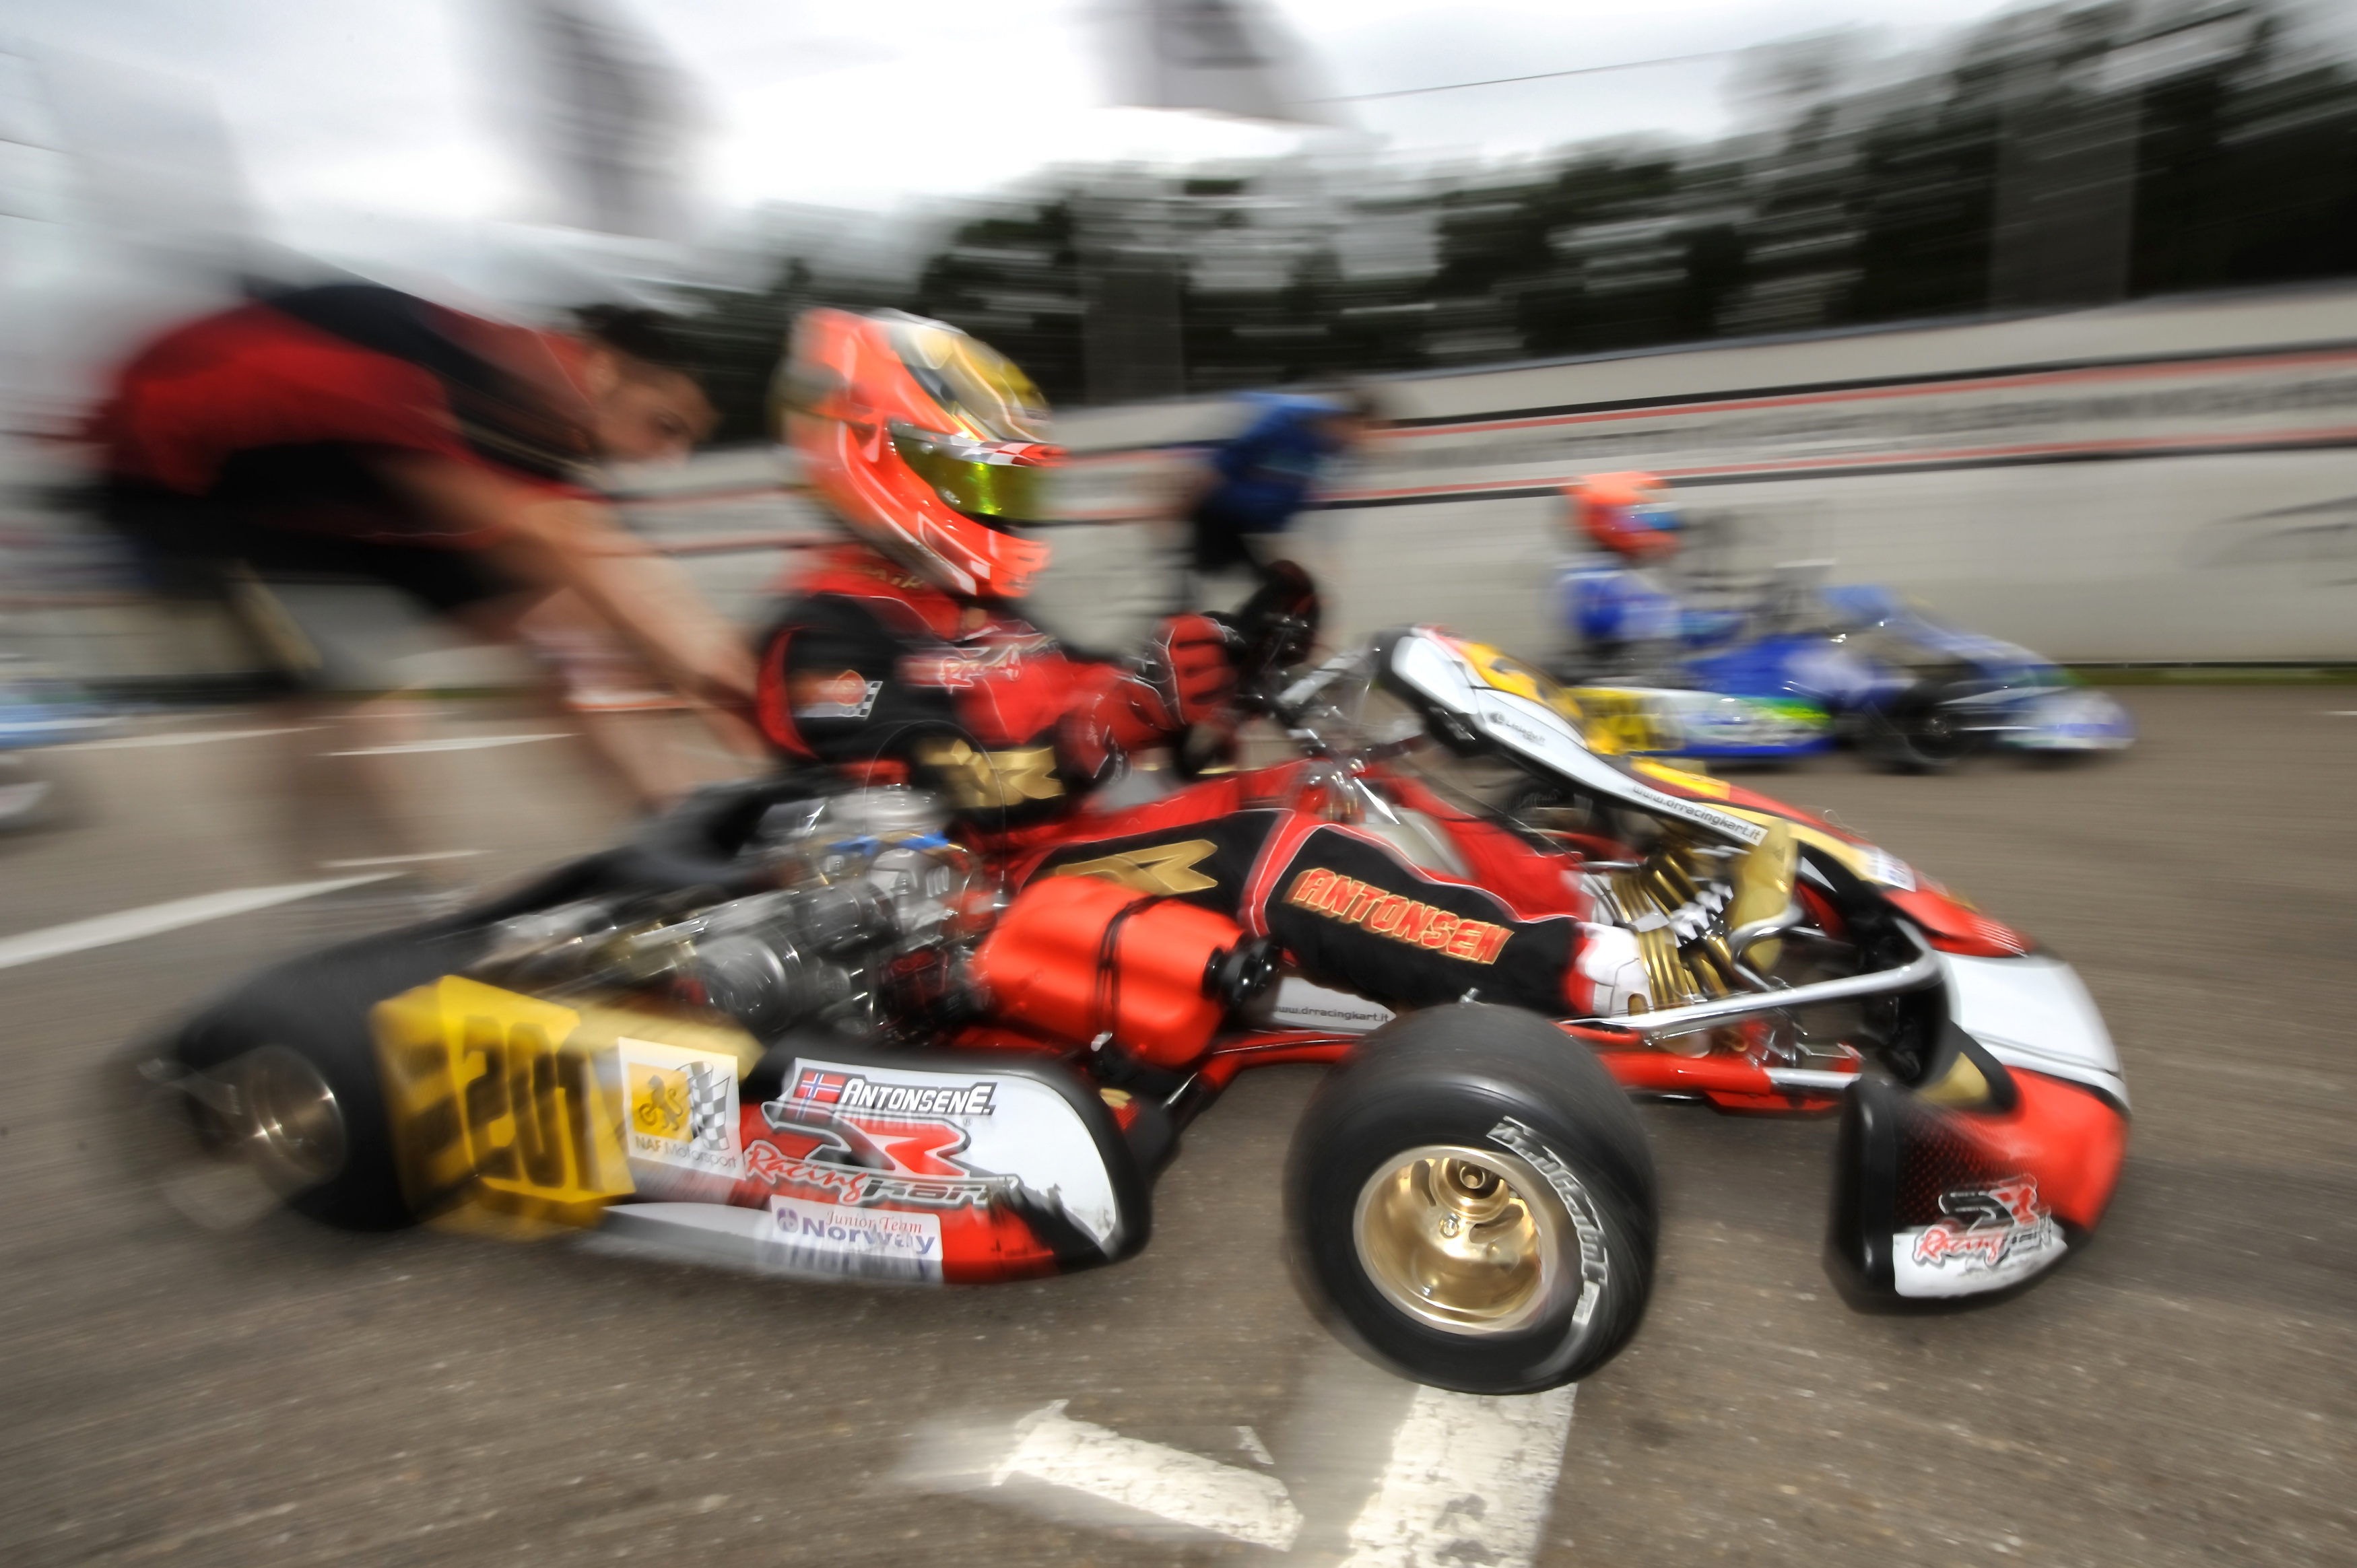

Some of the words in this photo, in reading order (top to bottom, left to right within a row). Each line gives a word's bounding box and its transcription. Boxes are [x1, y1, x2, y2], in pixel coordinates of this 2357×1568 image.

[1633, 784, 1761, 841] www.drracingkart.it
[1282, 868, 1515, 965] ANTONSEN
[635, 1136, 661, 1151] NAF
[665, 1143, 736, 1169] Motorsport
[748, 1143, 869, 1202] Racing
[801, 1217, 935, 1255] Norway
[826, 1211, 875, 1229] Junior
[879, 1217, 922, 1234] Team
